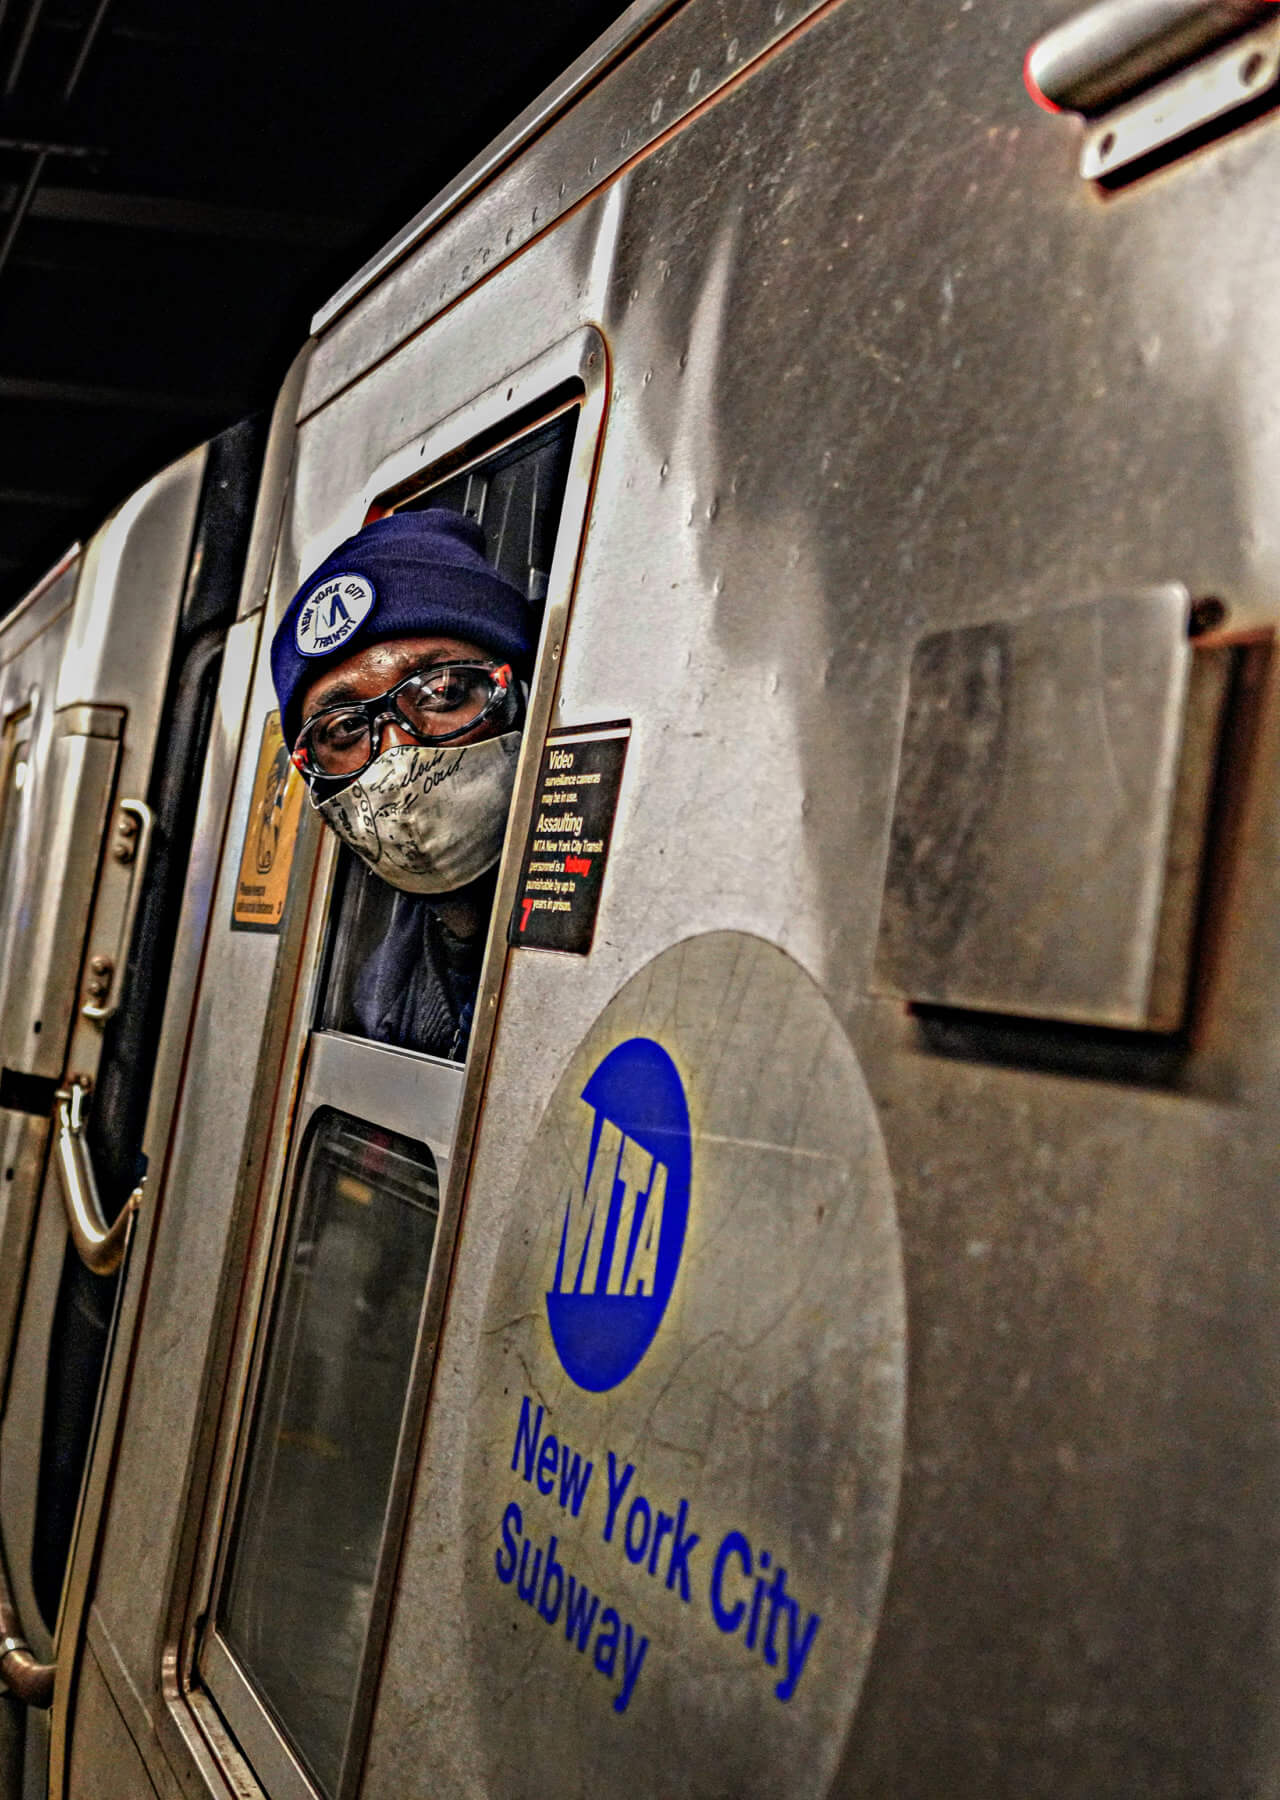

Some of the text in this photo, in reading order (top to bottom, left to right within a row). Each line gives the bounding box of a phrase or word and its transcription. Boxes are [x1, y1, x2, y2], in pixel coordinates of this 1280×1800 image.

[300, 582, 366, 636] NEW YORK CITY
[313, 617, 357, 649] TRANSIT
[549, 750, 574, 770] Video
[576, 773, 601, 785] cameras
[541, 794, 553, 807] may
[553, 791, 561, 804] be
[535, 811, 583, 837] Assaulting
[533, 838, 604, 855] MTA New York City Transit
[528, 861, 555, 874] personnel
[564, 855, 592, 878] felony
[525, 878, 554, 892] punishable
[520, 898, 534, 932] 7
[548, 1114, 669, 1298] MTA
[511, 1395, 821, 1700] New York City
[495, 1502, 649, 1714] Subway
